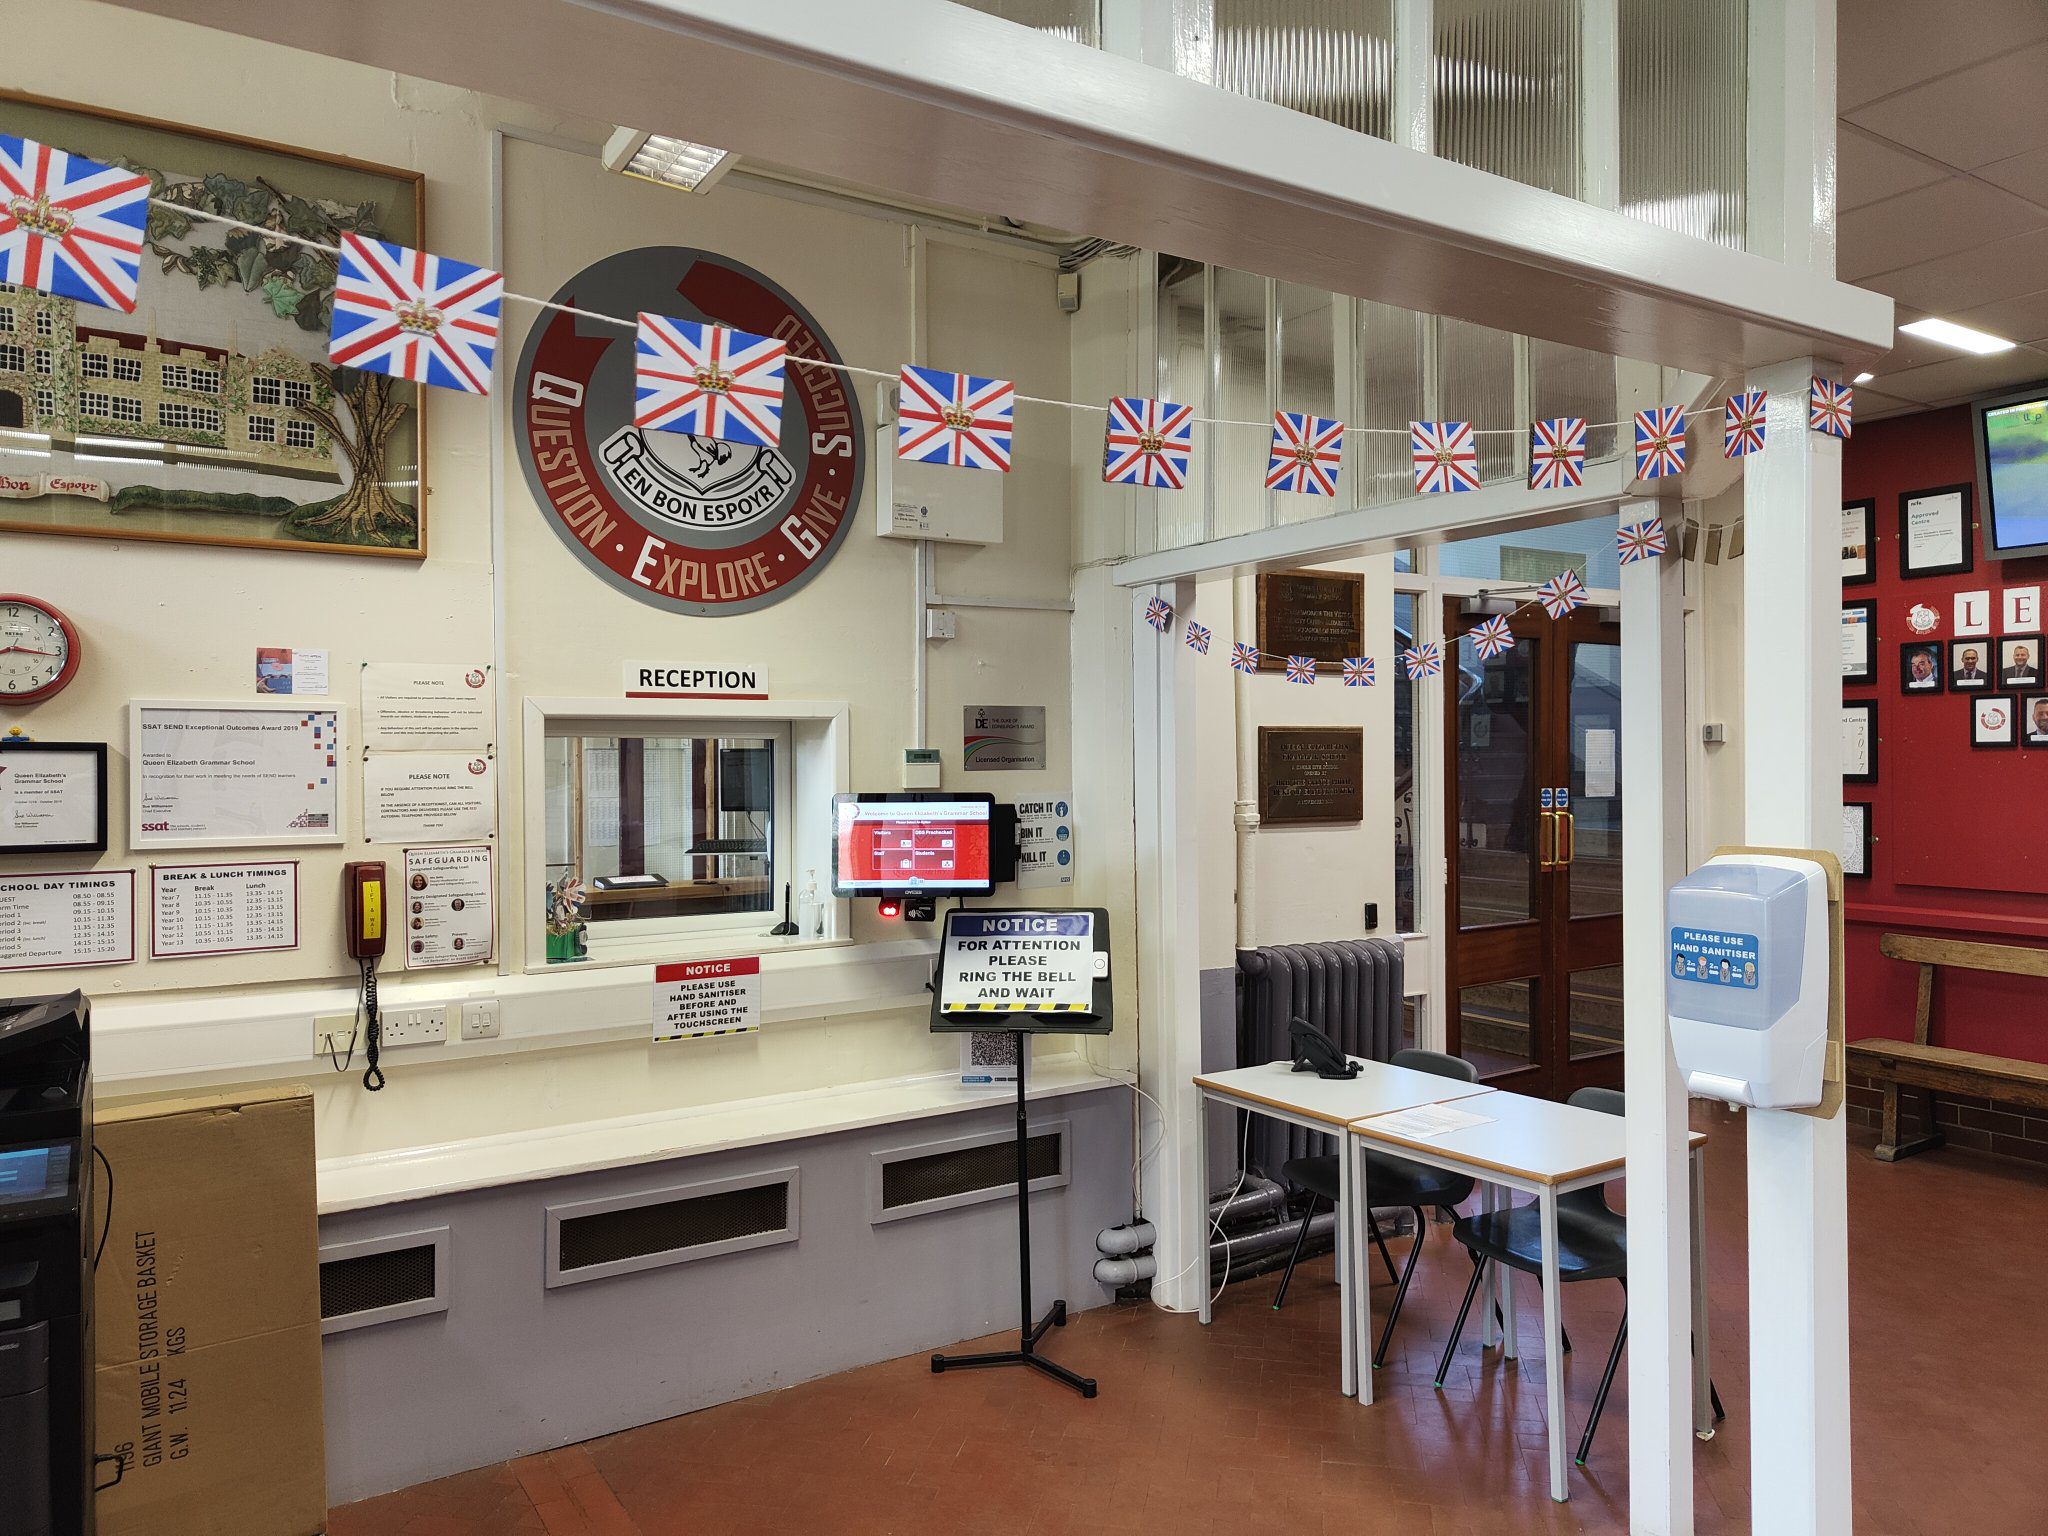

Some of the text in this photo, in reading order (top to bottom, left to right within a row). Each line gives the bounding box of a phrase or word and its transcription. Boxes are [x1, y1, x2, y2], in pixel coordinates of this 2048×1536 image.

[772, 314, 852, 458] SUCCEED
[531, 372, 618, 549] QUESTION
[624, 468, 775, 523] EN BON ESPOYR
[1911, 510, 1939, 519] Approved
[780, 483, 846, 560] GIVE
[631, 535, 777, 600] EXPLORE
[7, 607, 20, 618] 12
[1963, 601, 1983, 627] L
[2012, 596, 2032, 624] E
[33, 614, 39, 624] 1
[47, 626, 56, 637] 2
[55, 646, 62, 656] 3
[45, 666, 53, 675] 4
[8, 680, 16, 689] 6
[31, 676, 39, 686] 5
[639, 668, 756, 689] RECEPTION
[185, 724, 225, 732] Exceptional
[1020, 802, 1053, 814] CATCH IT
[141, 821, 170, 832] ssat
[1020, 827, 1043, 839] BIN IT
[408, 854, 488, 866] SAFEGUARDING
[1021, 851, 1047, 863] KILL IT
[163, 873, 197, 881] BREAK
[210, 871, 244, 879] LUNCH
[246, 869, 287, 877] TIMINGS
[44, 882, 65, 890] DAY
[69, 880, 116, 889] TIMINGS
[982, 918, 1058, 932] NOTICE
[1684, 932, 1744, 946] PLEASE USE
[957, 940, 1081, 951] FOR ATTENTION
[1673, 942, 1756, 960] HAND SANITISER
[28, 949, 62, 957] Departure
[989, 955, 1048, 966] PLEASE
[685, 963, 731, 976] NOTICE
[959, 971, 1077, 982] RING THE BELL
[680, 980, 736, 992] PLEASE USE
[669, 988, 746, 1002] HAND SANITISER
[977, 987, 1056, 998] AND WAIT
[679, 998, 737, 1011] BEFORE AND
[667, 1006, 749, 1021] AFTER USING THE
[674, 1016, 742, 1030] TOUCHSCREEN
[166, 1326, 186, 1357] KGS
[135, 1231, 162, 1468] GIANT MOBILE STORAGE BASKET
[168, 1378, 188, 1415] 11.24
